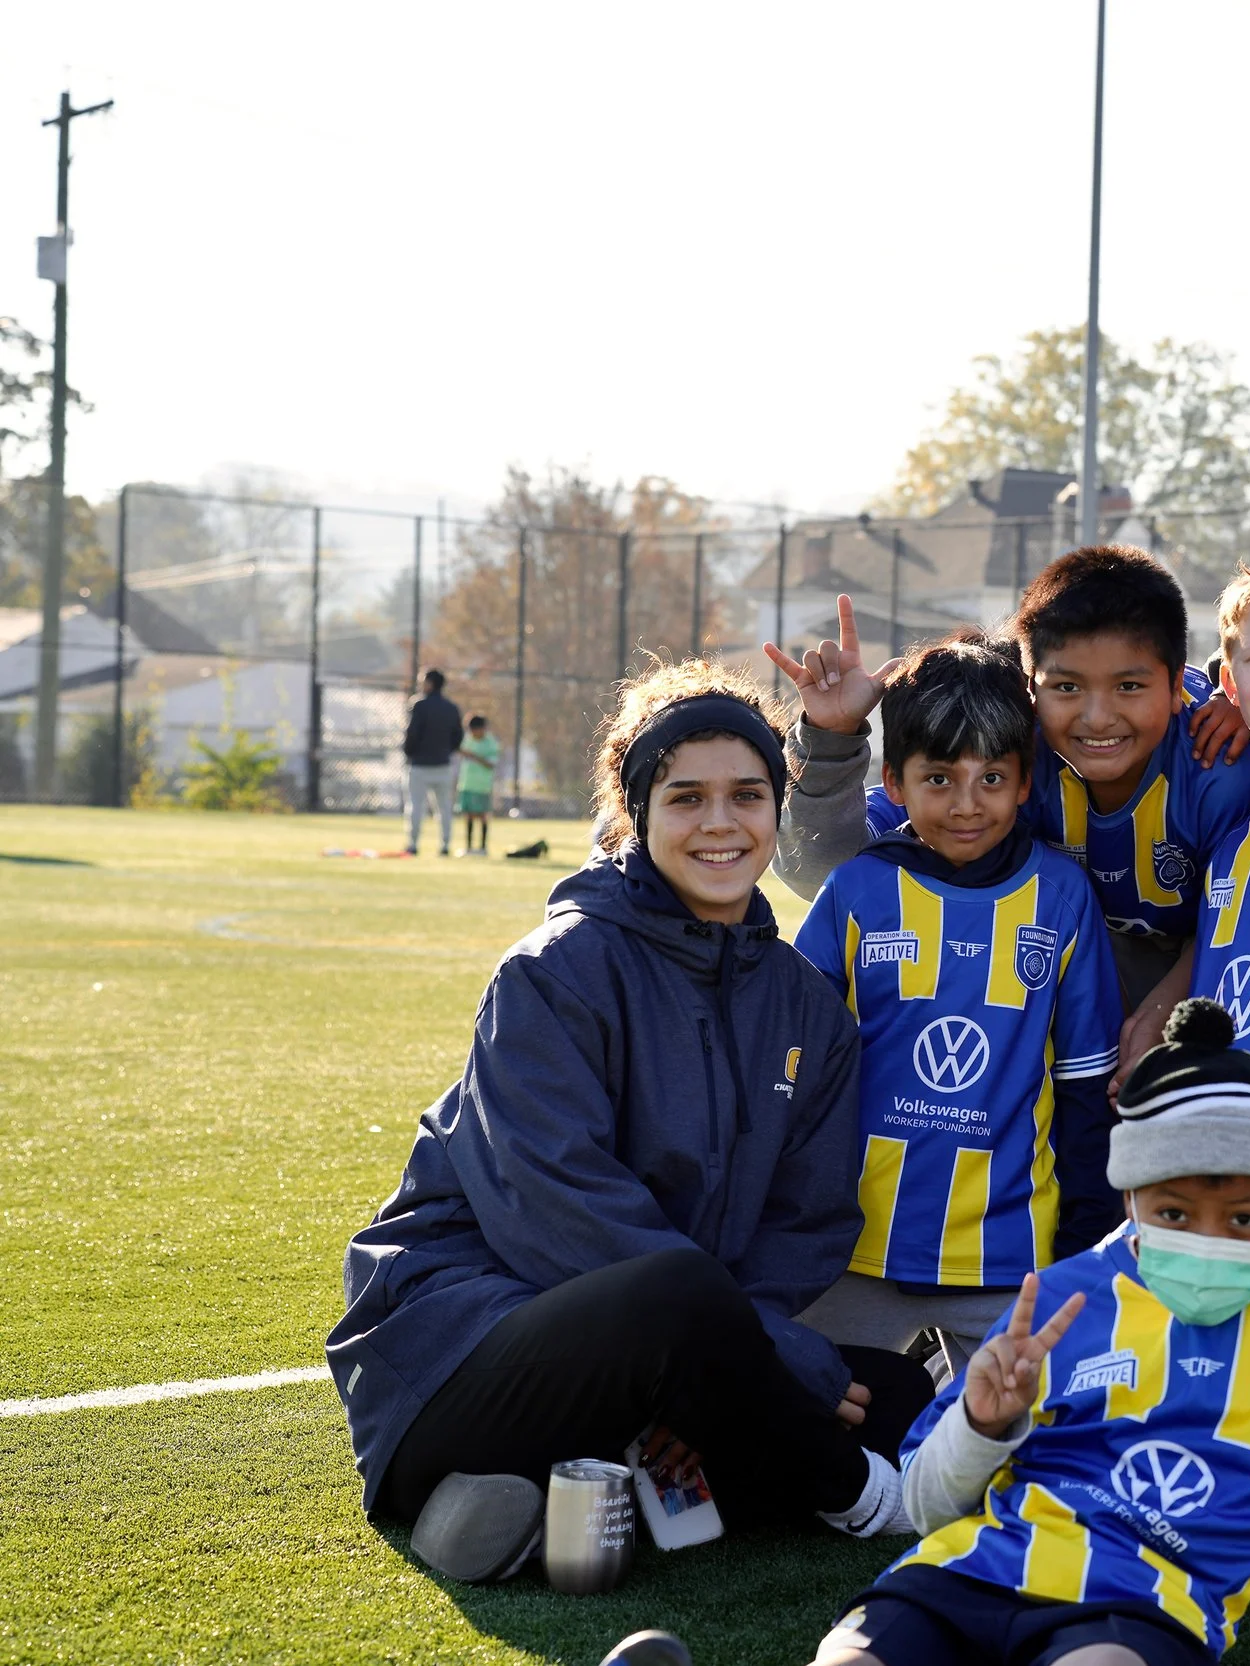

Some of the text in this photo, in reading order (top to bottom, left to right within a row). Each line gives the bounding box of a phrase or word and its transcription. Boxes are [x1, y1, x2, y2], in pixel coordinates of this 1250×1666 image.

[1209, 891, 1232, 907] CTIVE
[867, 932, 900, 940] OPERATION
[869, 944, 913, 961] ACTIVE
[893, 1096, 988, 1123] Volkswagen
[883, 1114, 991, 1137] WORKERS FOUNDATION
[1076, 1366, 1129, 1389] ACTIVE
[605, 1511, 621, 1524] you
[600, 1537, 625, 1550] things
